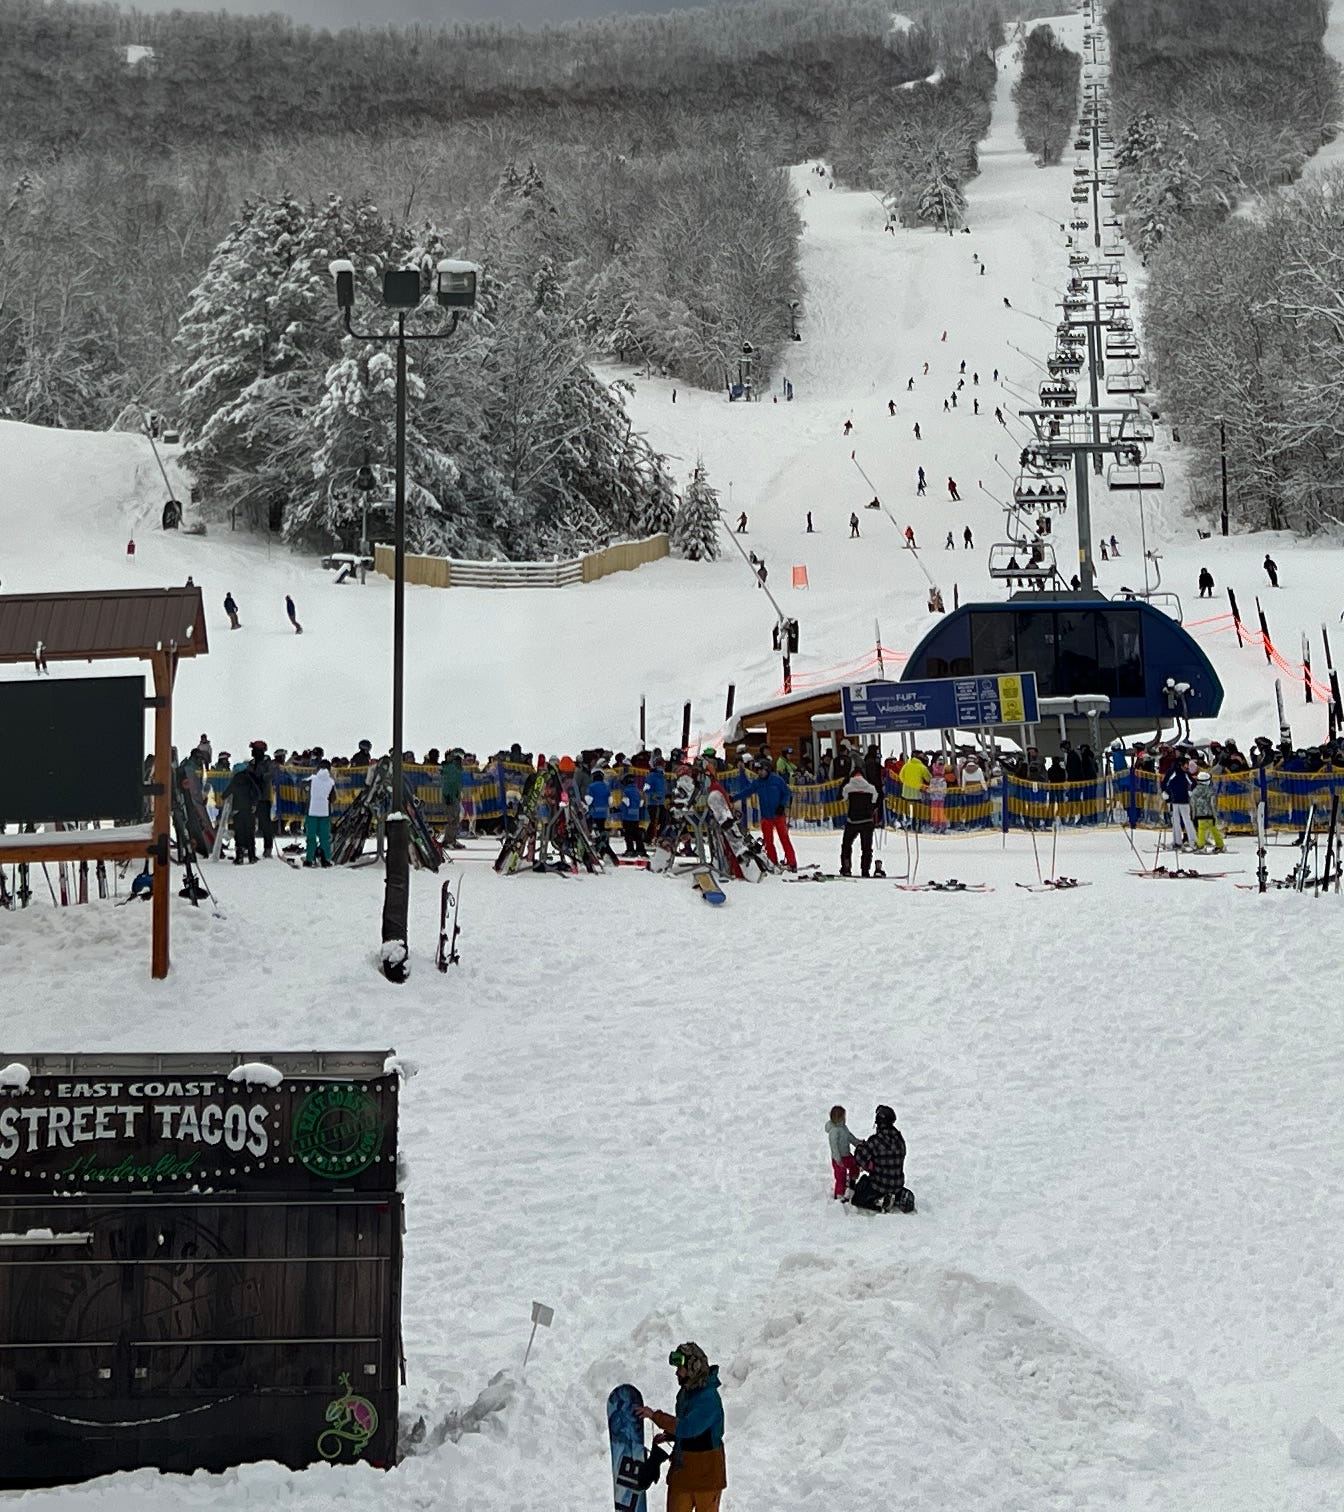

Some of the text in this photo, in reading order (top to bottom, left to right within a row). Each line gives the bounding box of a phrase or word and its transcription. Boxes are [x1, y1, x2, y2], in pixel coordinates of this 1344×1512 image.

[58, 1081, 216, 1097] EAST COAST
[154, 1103, 269, 1157] TACOS
